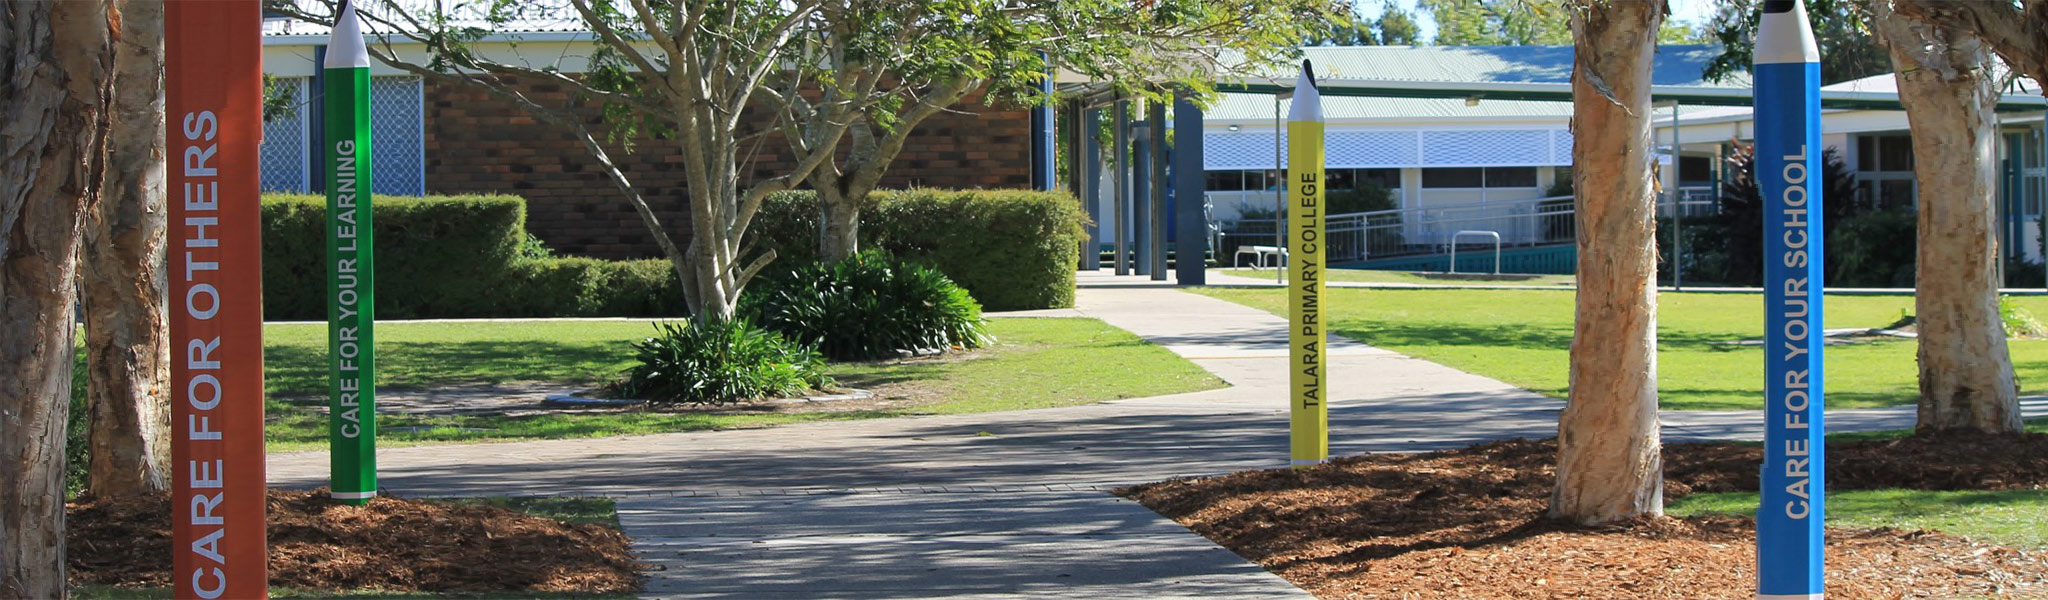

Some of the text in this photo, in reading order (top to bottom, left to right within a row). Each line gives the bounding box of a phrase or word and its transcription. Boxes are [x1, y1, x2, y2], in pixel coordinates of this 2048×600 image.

[183, 110, 226, 599] CARE FOR OTHERS
[336, 139, 360, 439] CARE FOR YOUR LEARNING
[1300, 172, 1319, 410] TALARA PRIMARY COLLEGE
[1783, 144, 1810, 520] CARE FOR YOUR SCHOOL
